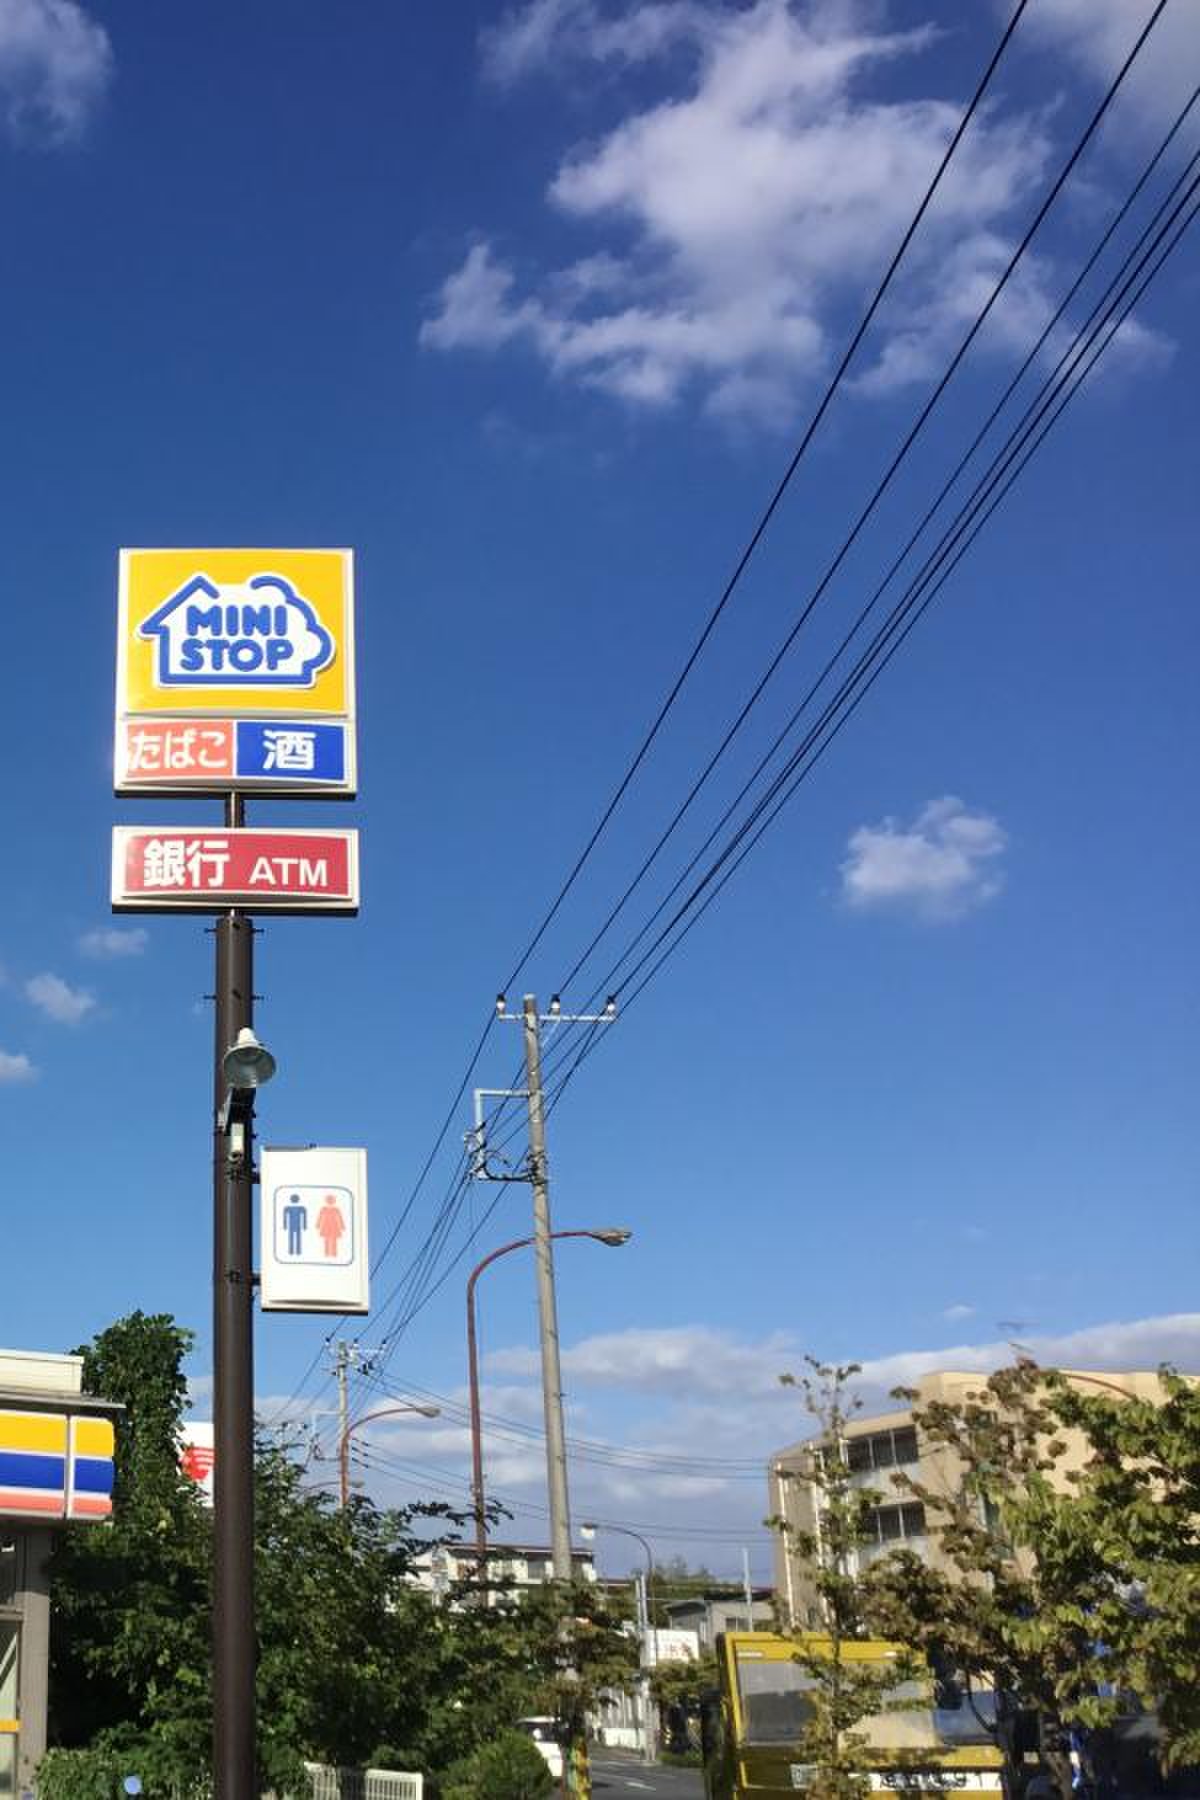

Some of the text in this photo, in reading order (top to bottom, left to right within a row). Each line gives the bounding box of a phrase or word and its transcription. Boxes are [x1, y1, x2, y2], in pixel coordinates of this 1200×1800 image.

[186, 604, 289, 637] MINI
[180, 638, 294, 673] STOP
[127, 729, 228, 770] たばこ
[263, 729, 316, 771] 酒
[143, 839, 328, 888] 銀行 ATM
